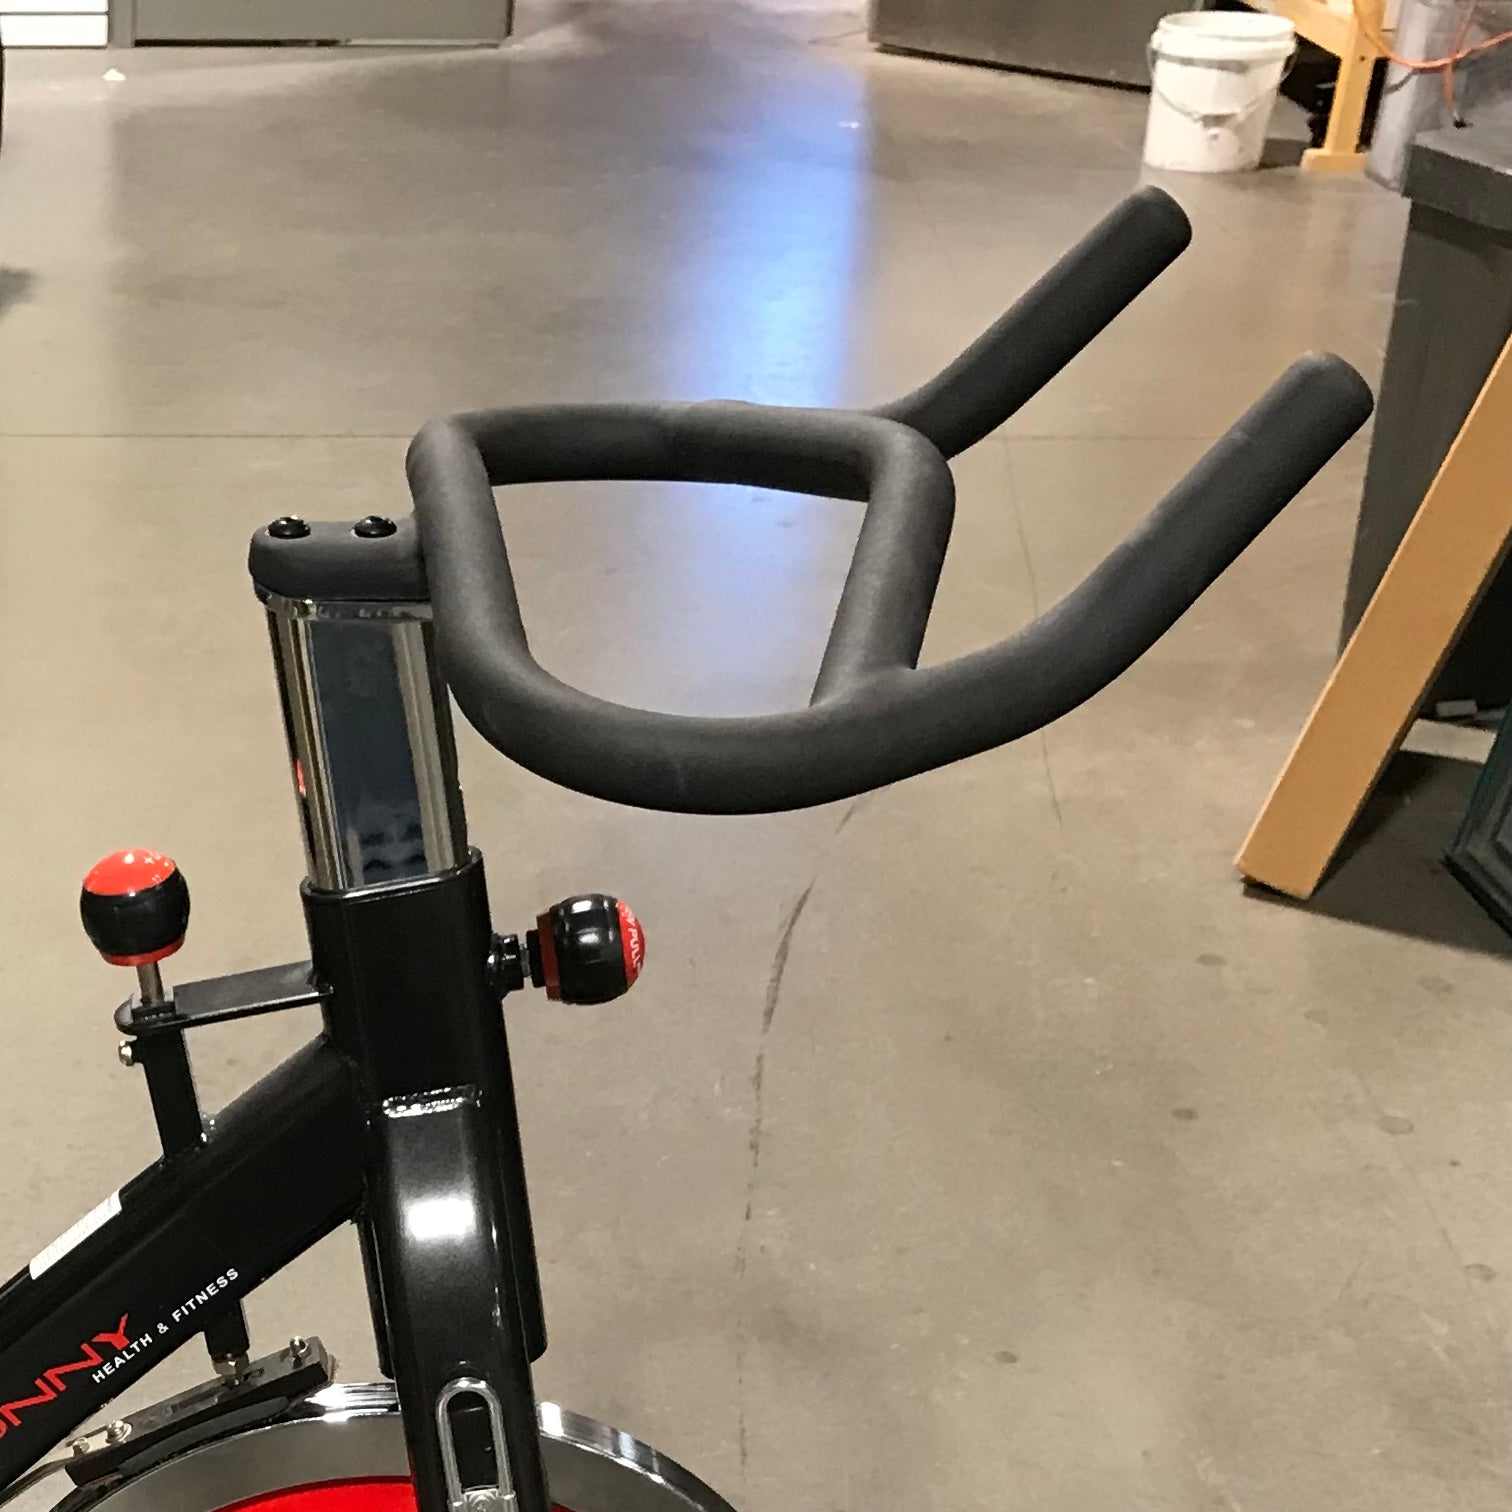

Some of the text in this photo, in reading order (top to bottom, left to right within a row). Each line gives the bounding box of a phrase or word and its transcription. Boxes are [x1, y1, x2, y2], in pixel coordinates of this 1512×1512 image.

[91, 1267, 240, 1384] HEALTH & FITNESS
